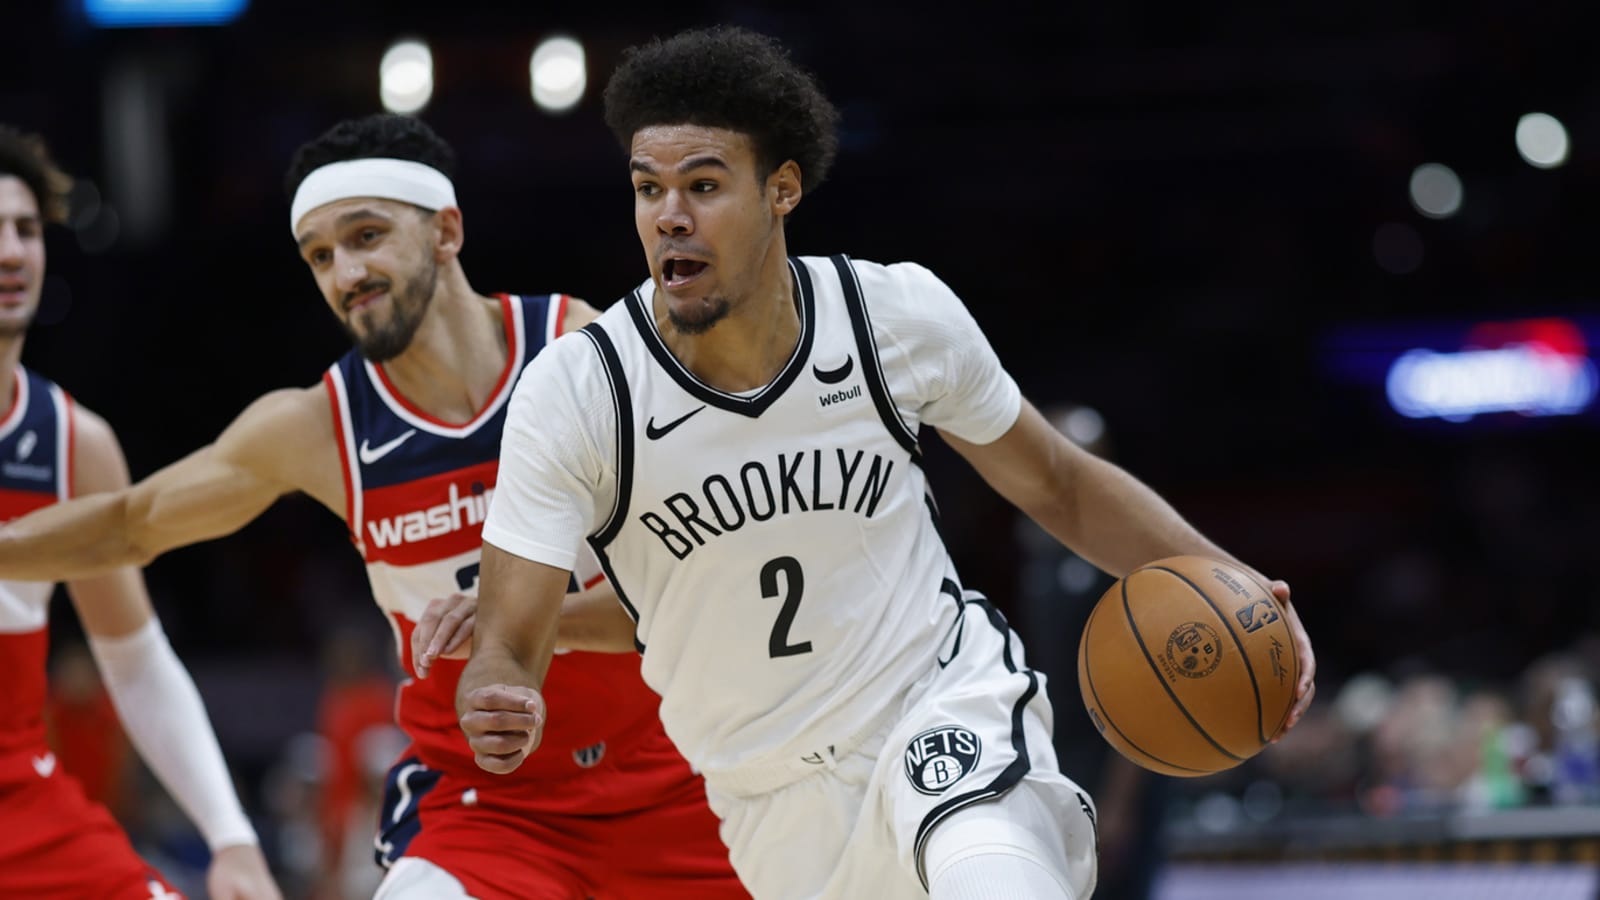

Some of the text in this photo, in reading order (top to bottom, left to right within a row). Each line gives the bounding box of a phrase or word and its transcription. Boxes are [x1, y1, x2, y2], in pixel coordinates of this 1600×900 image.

[819, 385, 862, 407] Webull
[639, 448, 894, 561] BROOKLYN
[759, 556, 813, 659] 2
[906, 729, 976, 777] NETS
[934, 760, 949, 784] B
